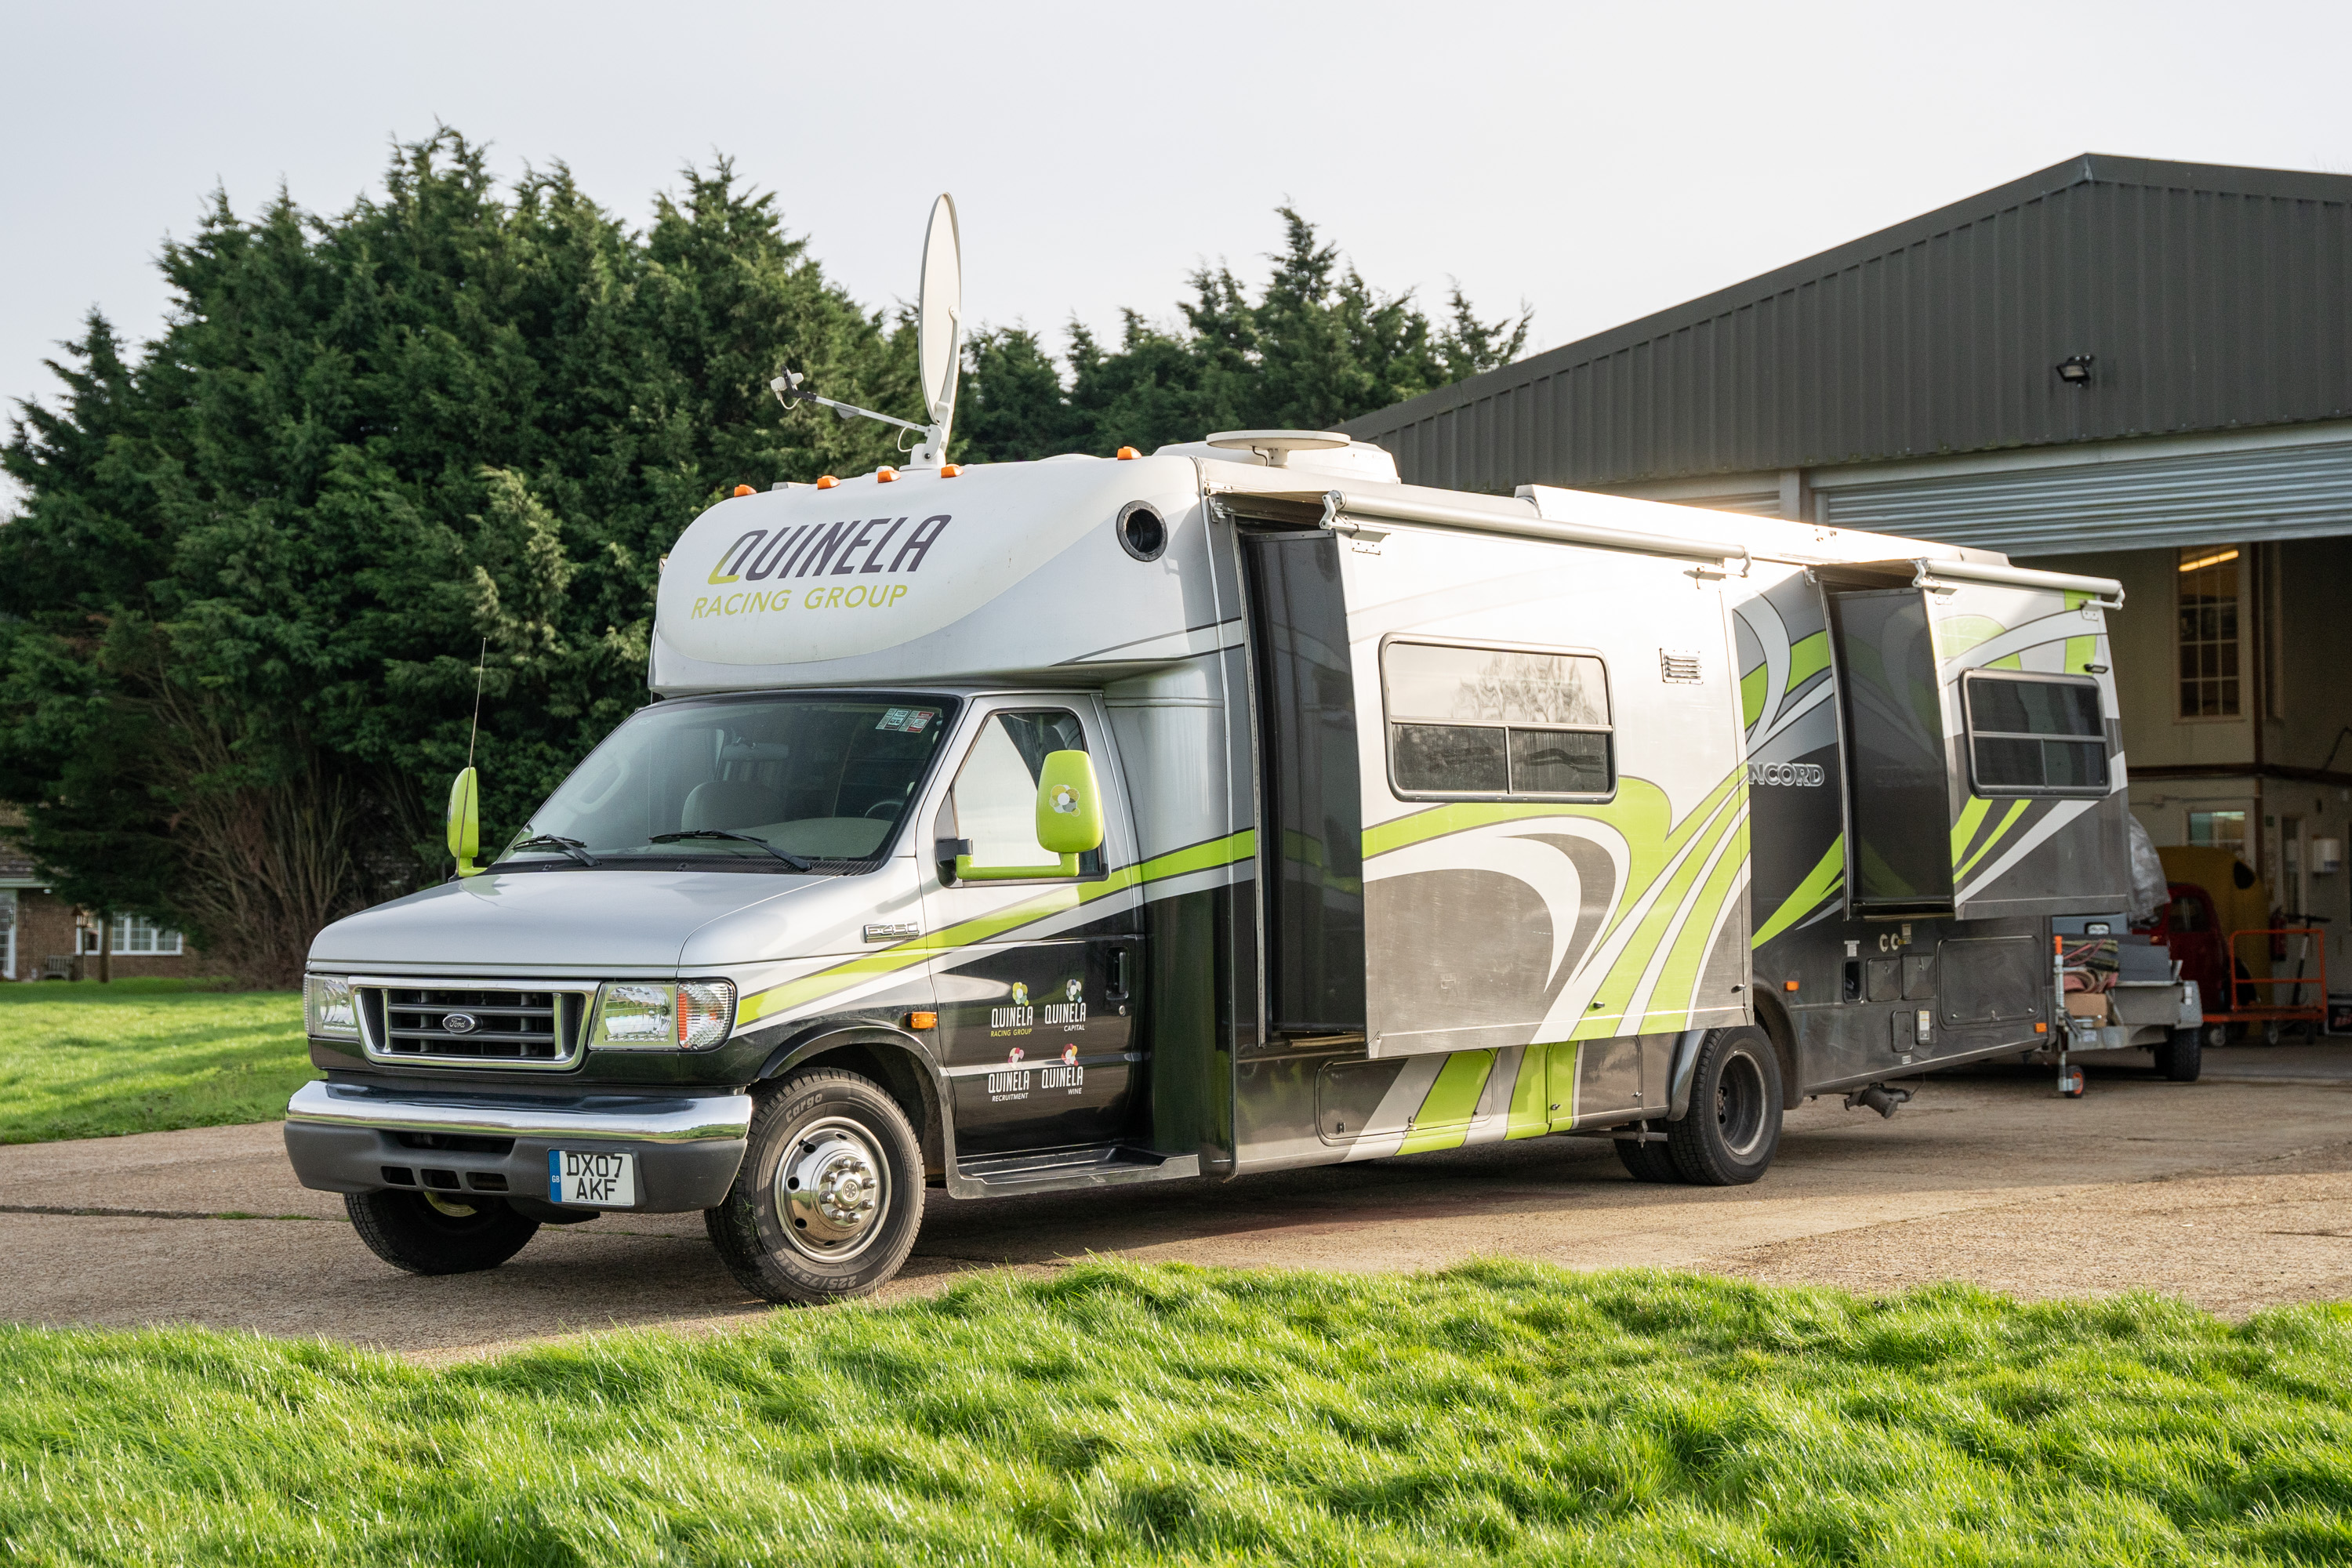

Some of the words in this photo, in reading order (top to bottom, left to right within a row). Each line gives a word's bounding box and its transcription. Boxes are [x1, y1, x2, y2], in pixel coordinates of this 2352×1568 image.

[707, 514, 953, 585] QUINELA
[691, 589, 792, 619] RACING
[804, 585, 908, 609] GROUP
[449, 1018, 466, 1028] Ford
[991, 1006, 1033, 1029] QUINELA
[1044, 1002, 1087, 1025] QUINELA
[988, 1070, 1030, 1094] QUINELA
[1041, 1065, 1083, 1089] QUINELA
[786, 1093, 823, 1123] Cargo
[992, 1093, 1029, 1102] RECRUITMENT
[566, 1153, 623, 1178] DX07
[575, 1178, 617, 1200] AKF
